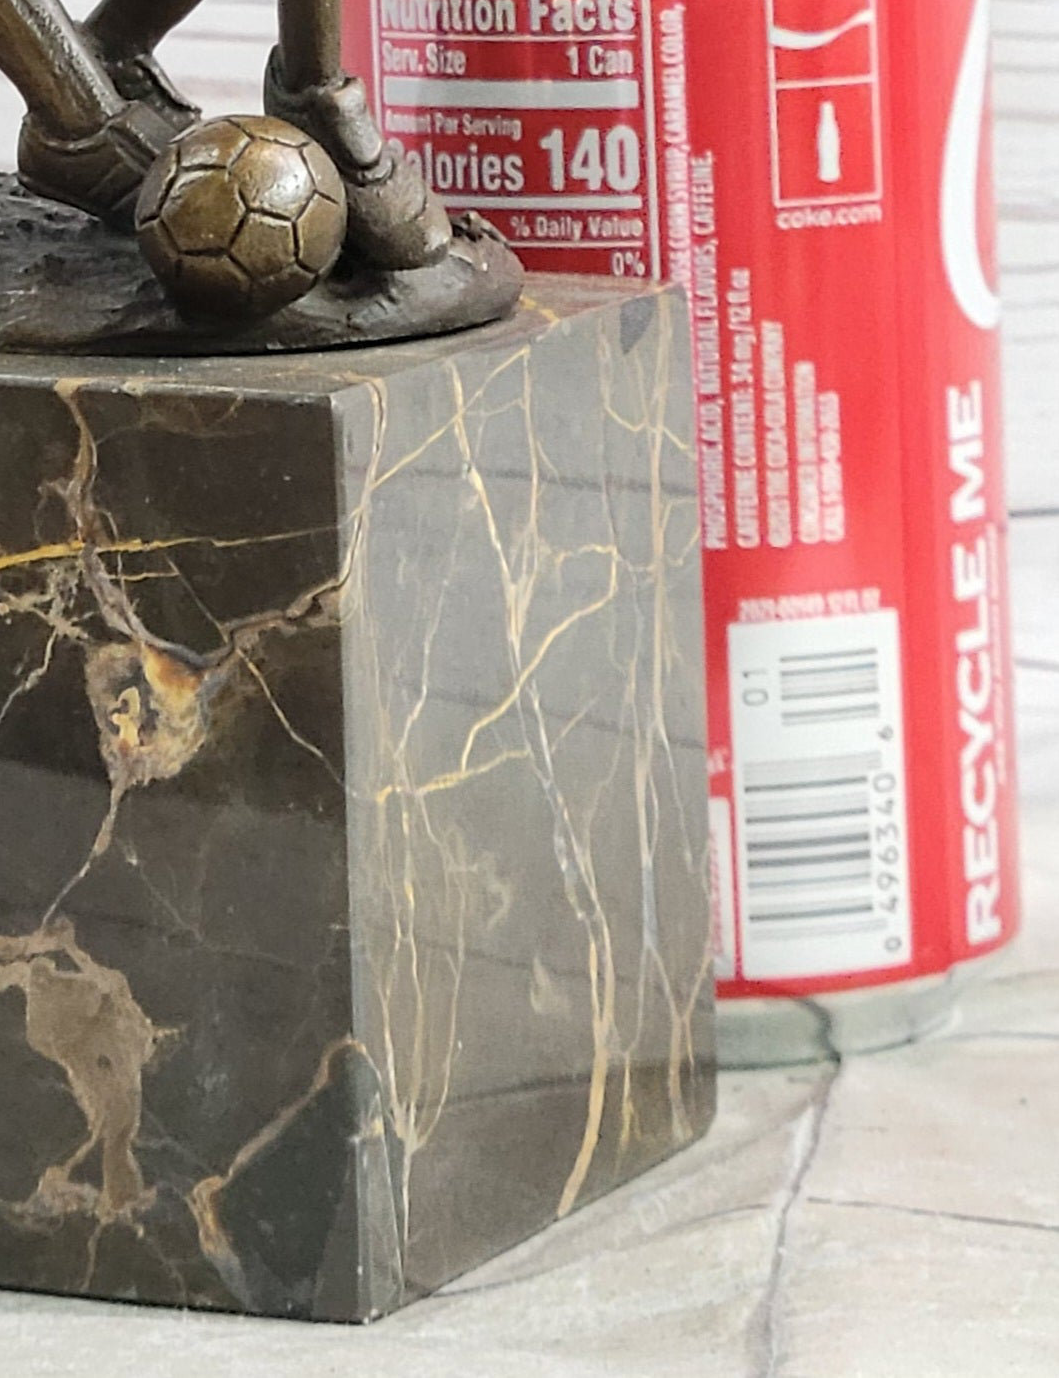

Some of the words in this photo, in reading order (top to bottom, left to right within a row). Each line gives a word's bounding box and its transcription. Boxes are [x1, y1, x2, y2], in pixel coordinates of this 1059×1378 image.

[382, 42, 424, 73] Serv.
[425, 43, 467, 76] Size
[566, 46, 579, 76] 1
[588, 45, 634, 76] Can
[462, 113, 522, 141] Serving
[539, 124, 641, 191] 140
[536, 216, 584, 241] Daily
[588, 216, 643, 237] Value
[776, 204, 882, 230] coke.com
[611, 252, 645, 275] 0%
[696, 320, 722, 394] NATURAL
[945, 380, 987, 524] ME
[742, 670, 770, 707] 01
[951, 536, 1003, 946] RECYCLE
